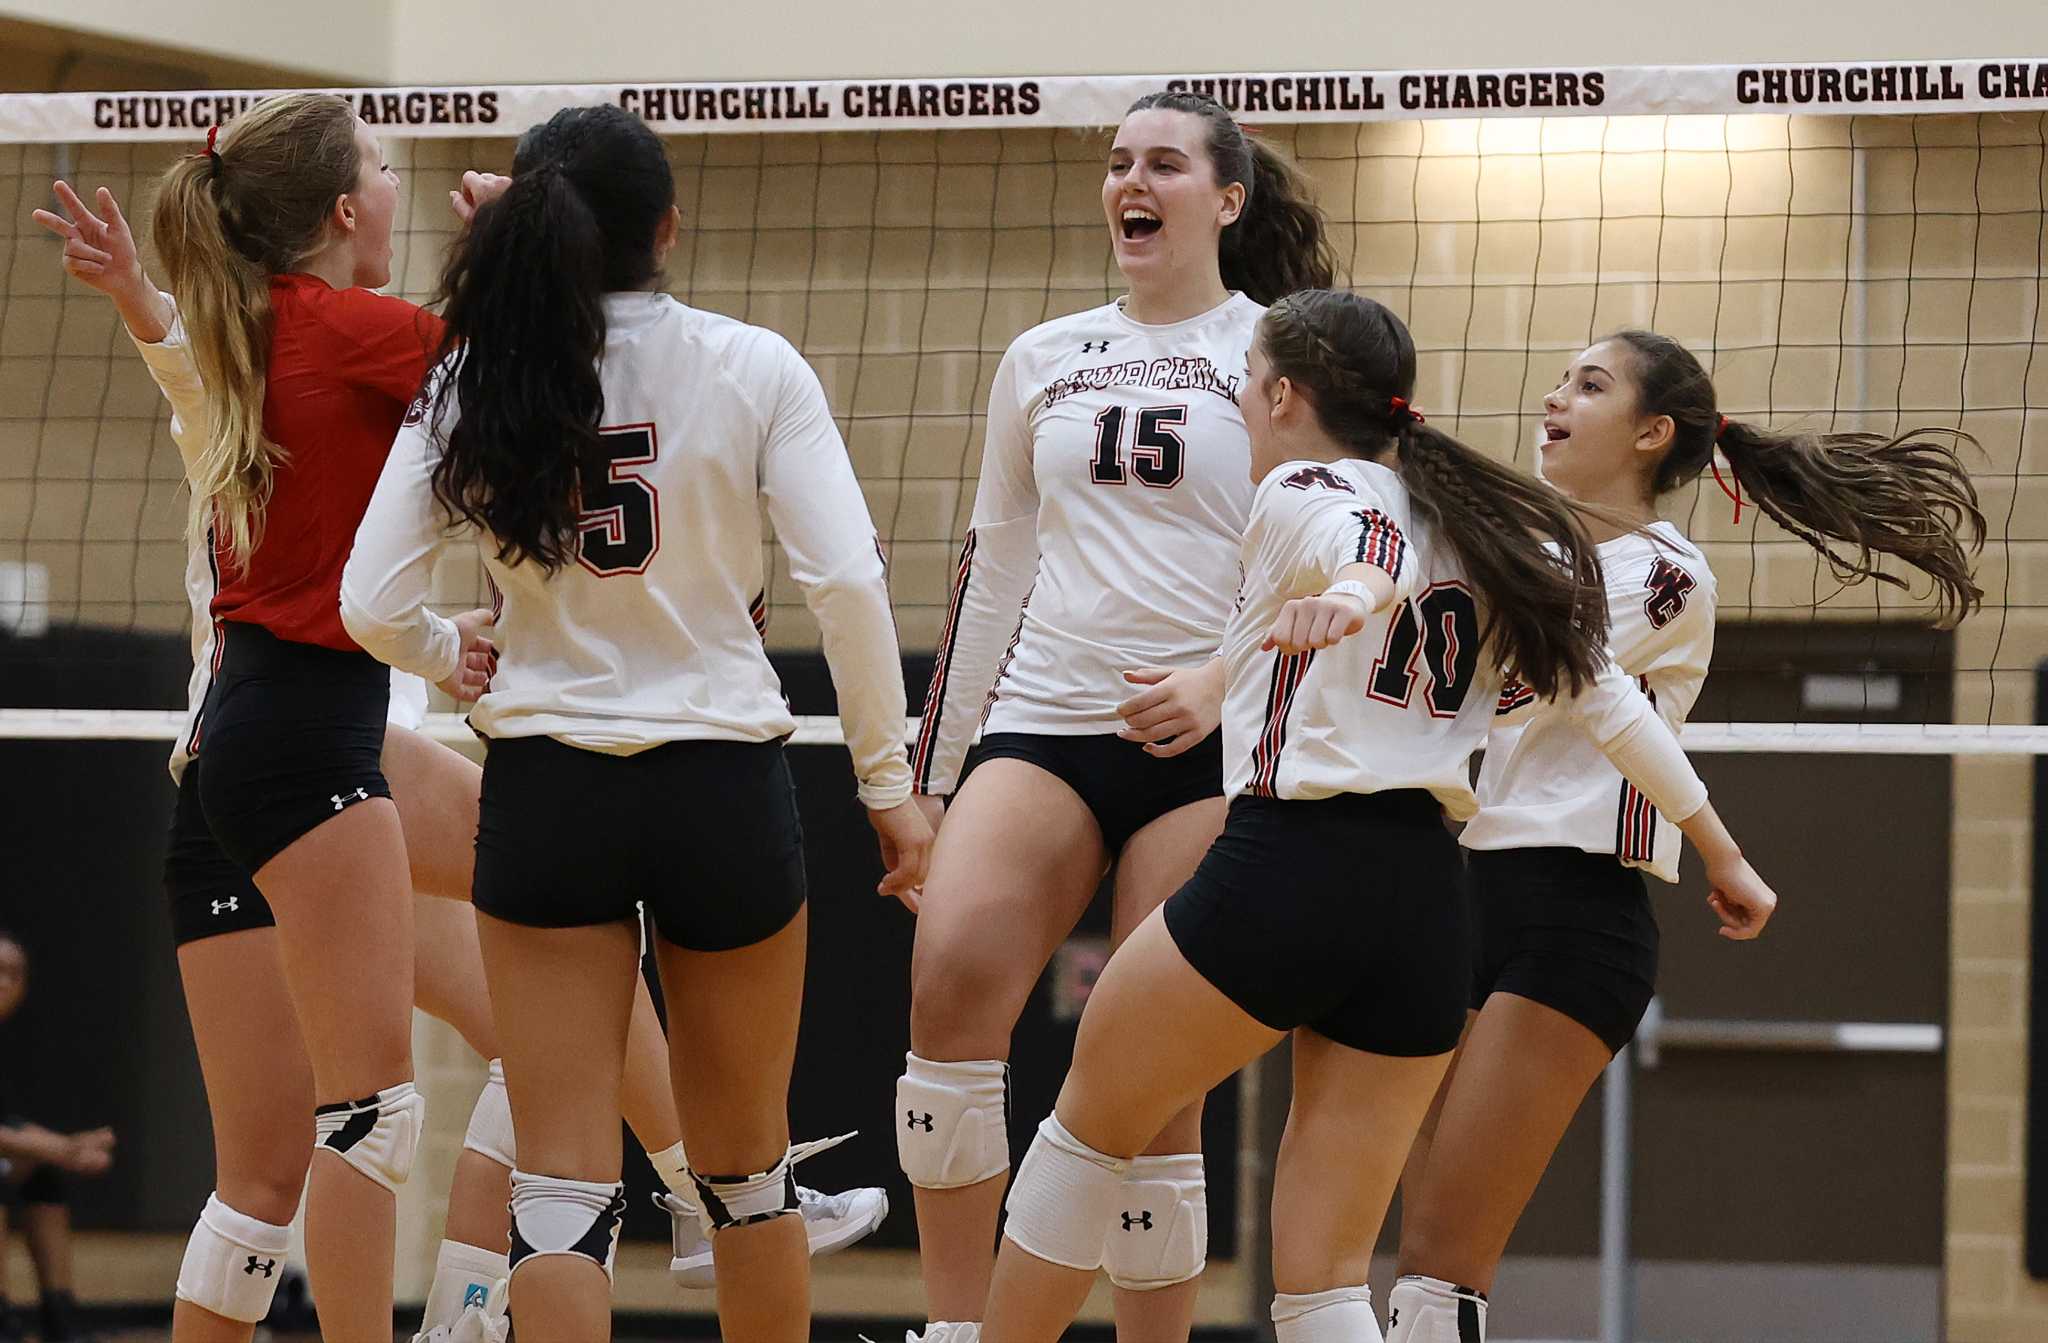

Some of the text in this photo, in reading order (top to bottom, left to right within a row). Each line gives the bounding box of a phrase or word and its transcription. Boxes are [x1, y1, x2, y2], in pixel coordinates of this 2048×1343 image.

[620, 82, 1041, 121] CHURCHILL CHARGERS
[1399, 72, 1606, 109] CHARGERS
[1736, 66, 1964, 104] CHURCHILL
[94, 91, 499, 129] CHURCH ARGERS
[1089, 404, 1188, 490] 15
[576, 422, 660, 578] 5
[1366, 579, 1480, 719] 10
